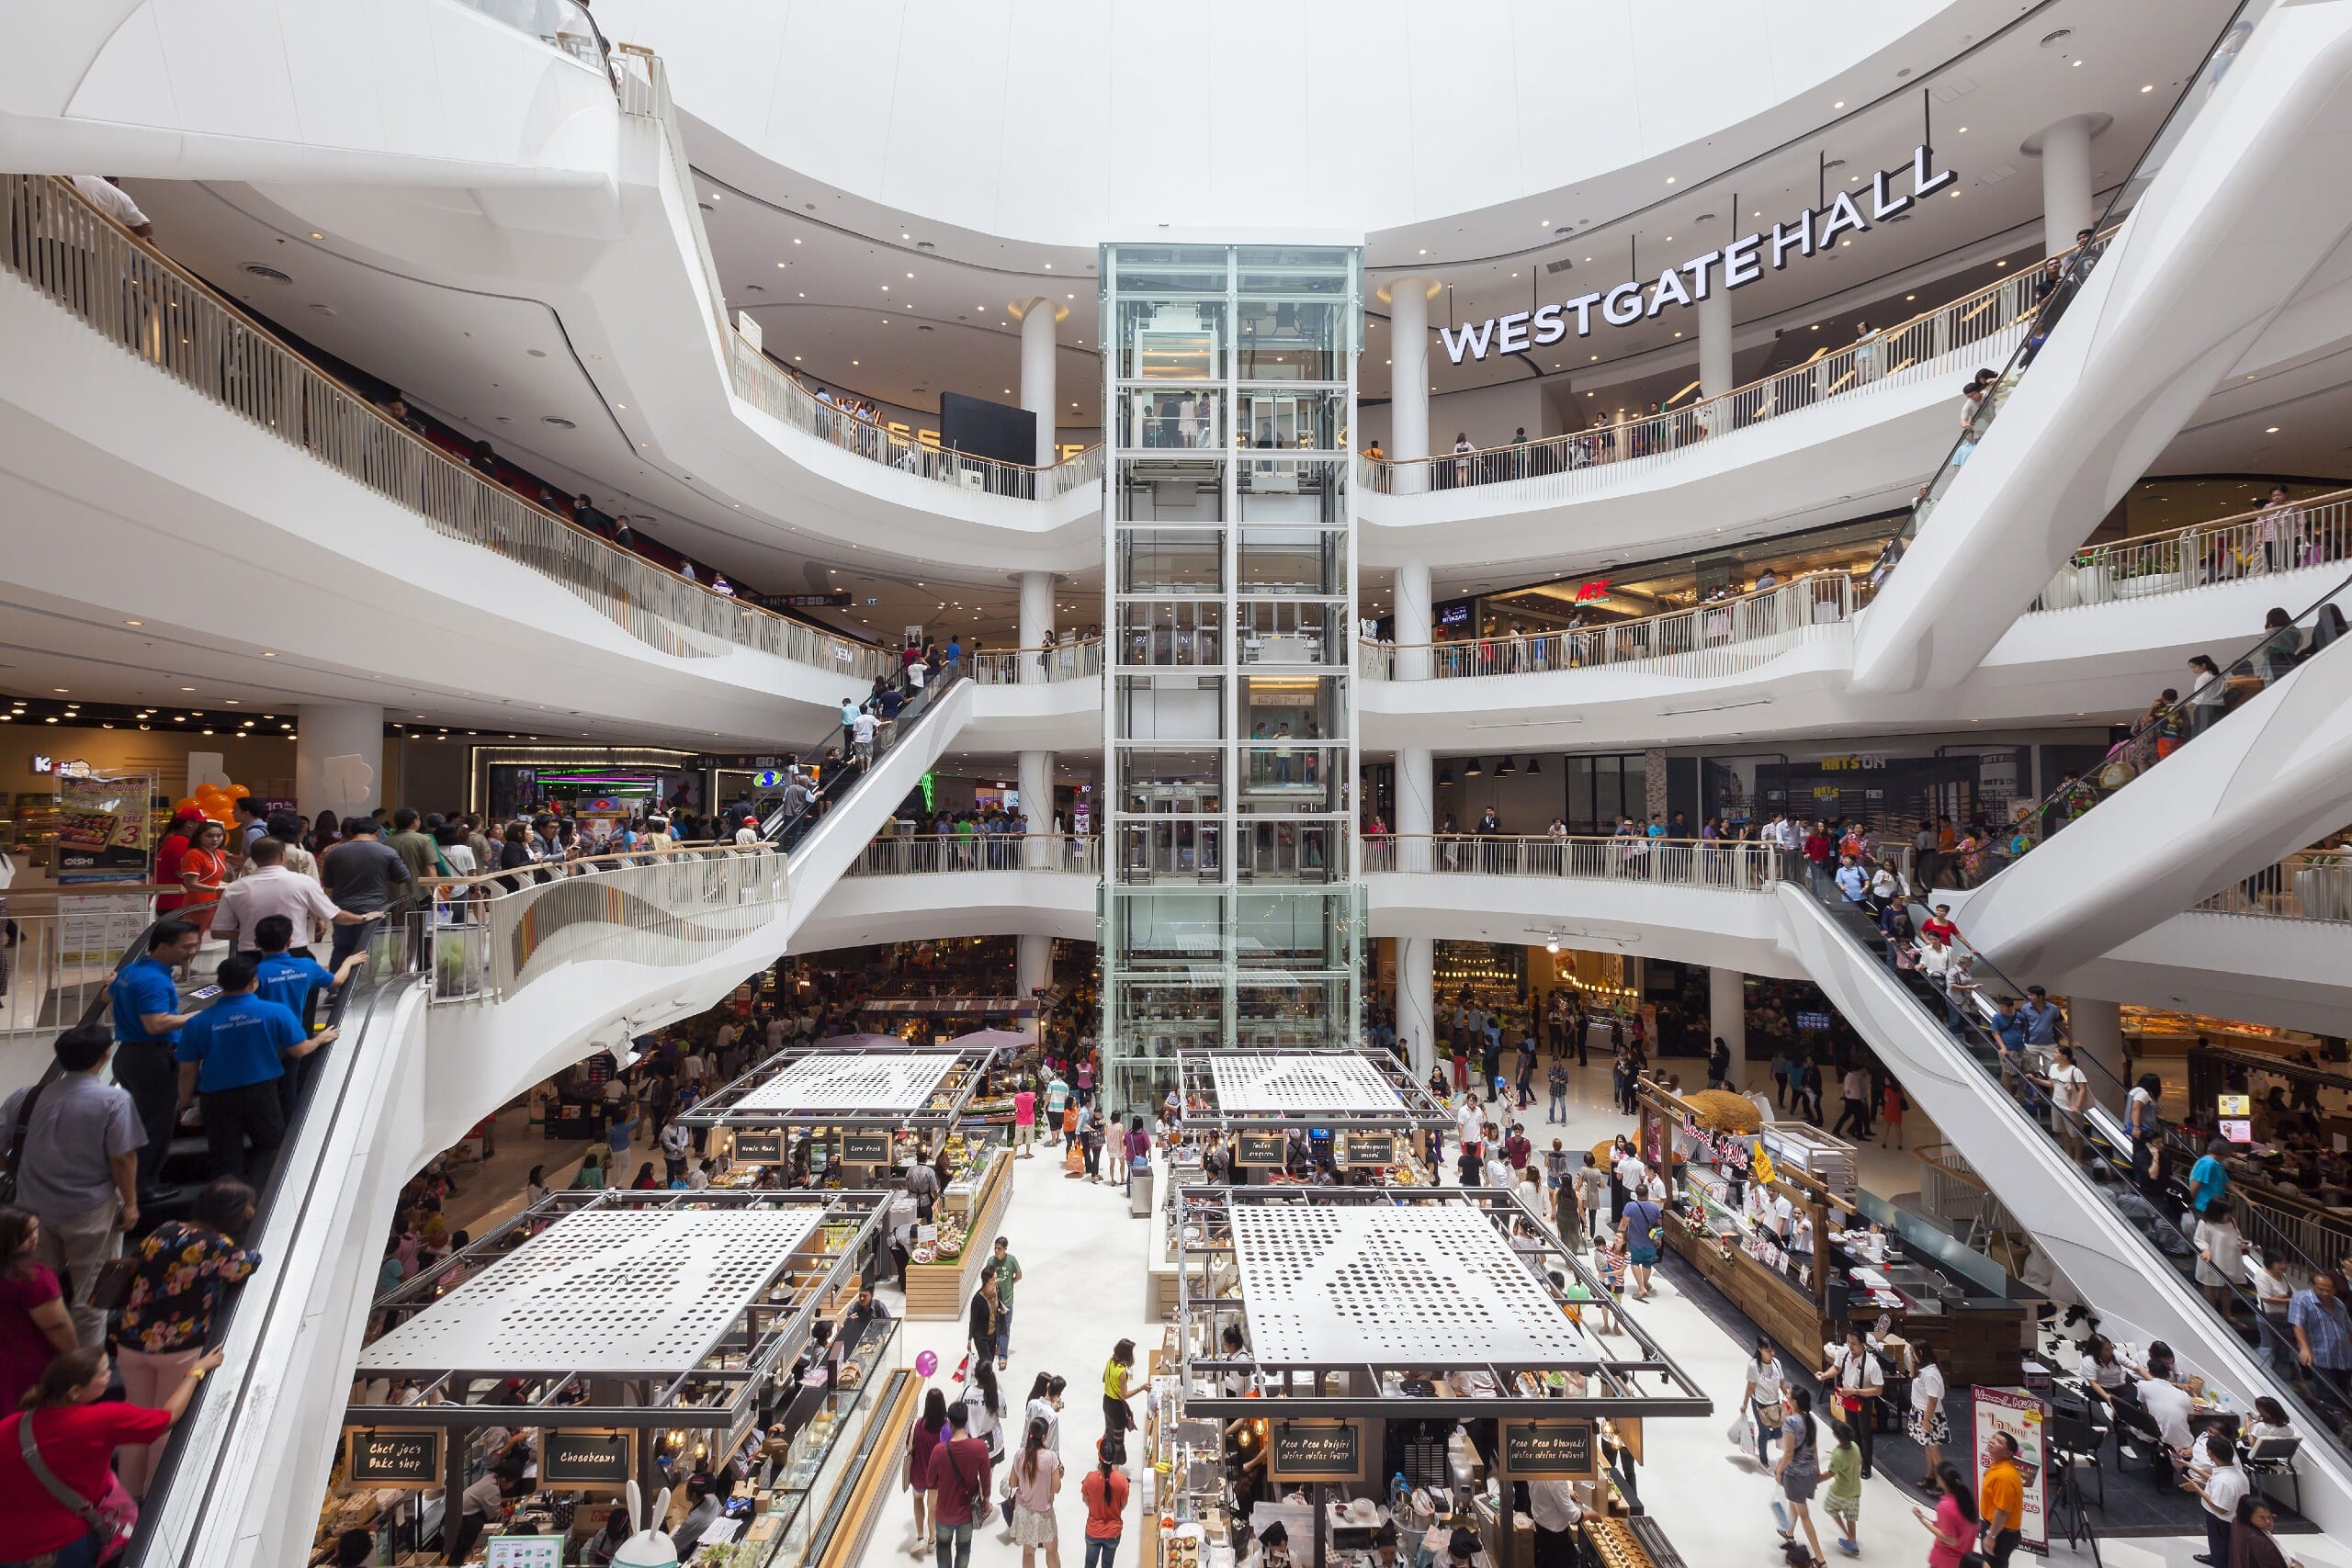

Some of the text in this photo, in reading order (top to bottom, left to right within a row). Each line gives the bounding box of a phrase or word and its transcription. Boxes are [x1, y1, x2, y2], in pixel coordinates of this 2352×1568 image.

[1440, 144, 1958, 367] WESTGATE HALL
[1861, 755, 1886, 770] ON
[119, 825, 141, 844] 3
[64, 858, 94, 866] OISHI
[369, 1443, 422, 1455] Chef joe's
[1323, 1439, 1351, 1450] Onigiri
[369, 1457, 421, 1471] Bake shop
[560, 1451, 616, 1464] Chocobeans
